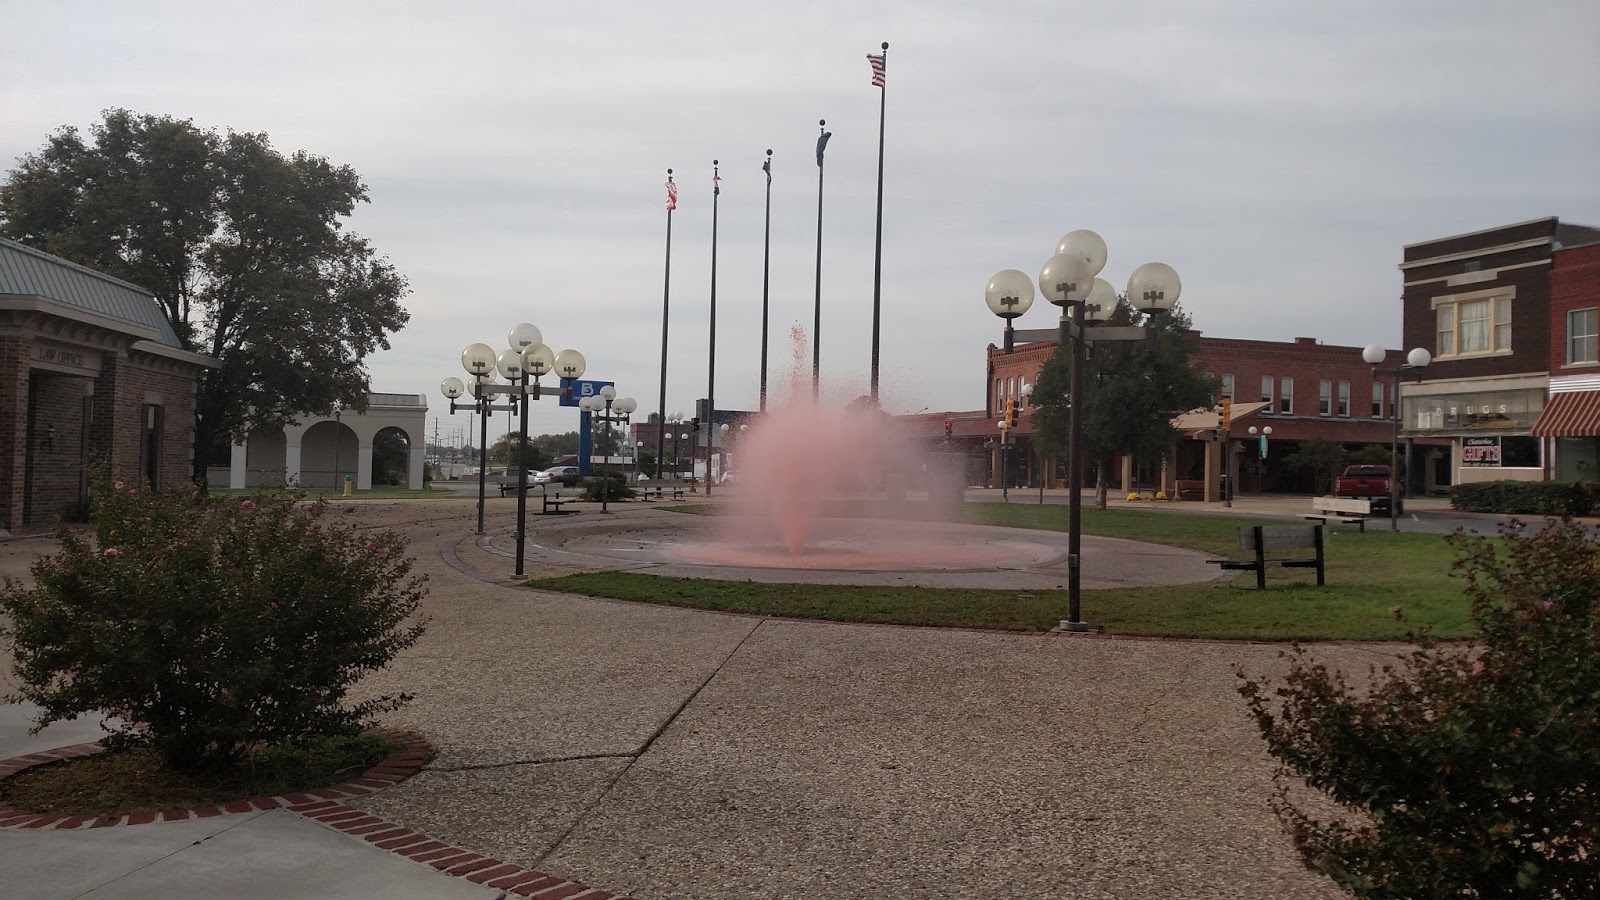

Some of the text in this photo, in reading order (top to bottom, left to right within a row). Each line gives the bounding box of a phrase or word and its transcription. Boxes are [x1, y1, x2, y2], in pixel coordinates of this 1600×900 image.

[40, 349, 83, 367] LAW OFFICE
[1436, 404, 1506, 416] DRUGS
[1463, 445, 1500, 461] GIFTS
